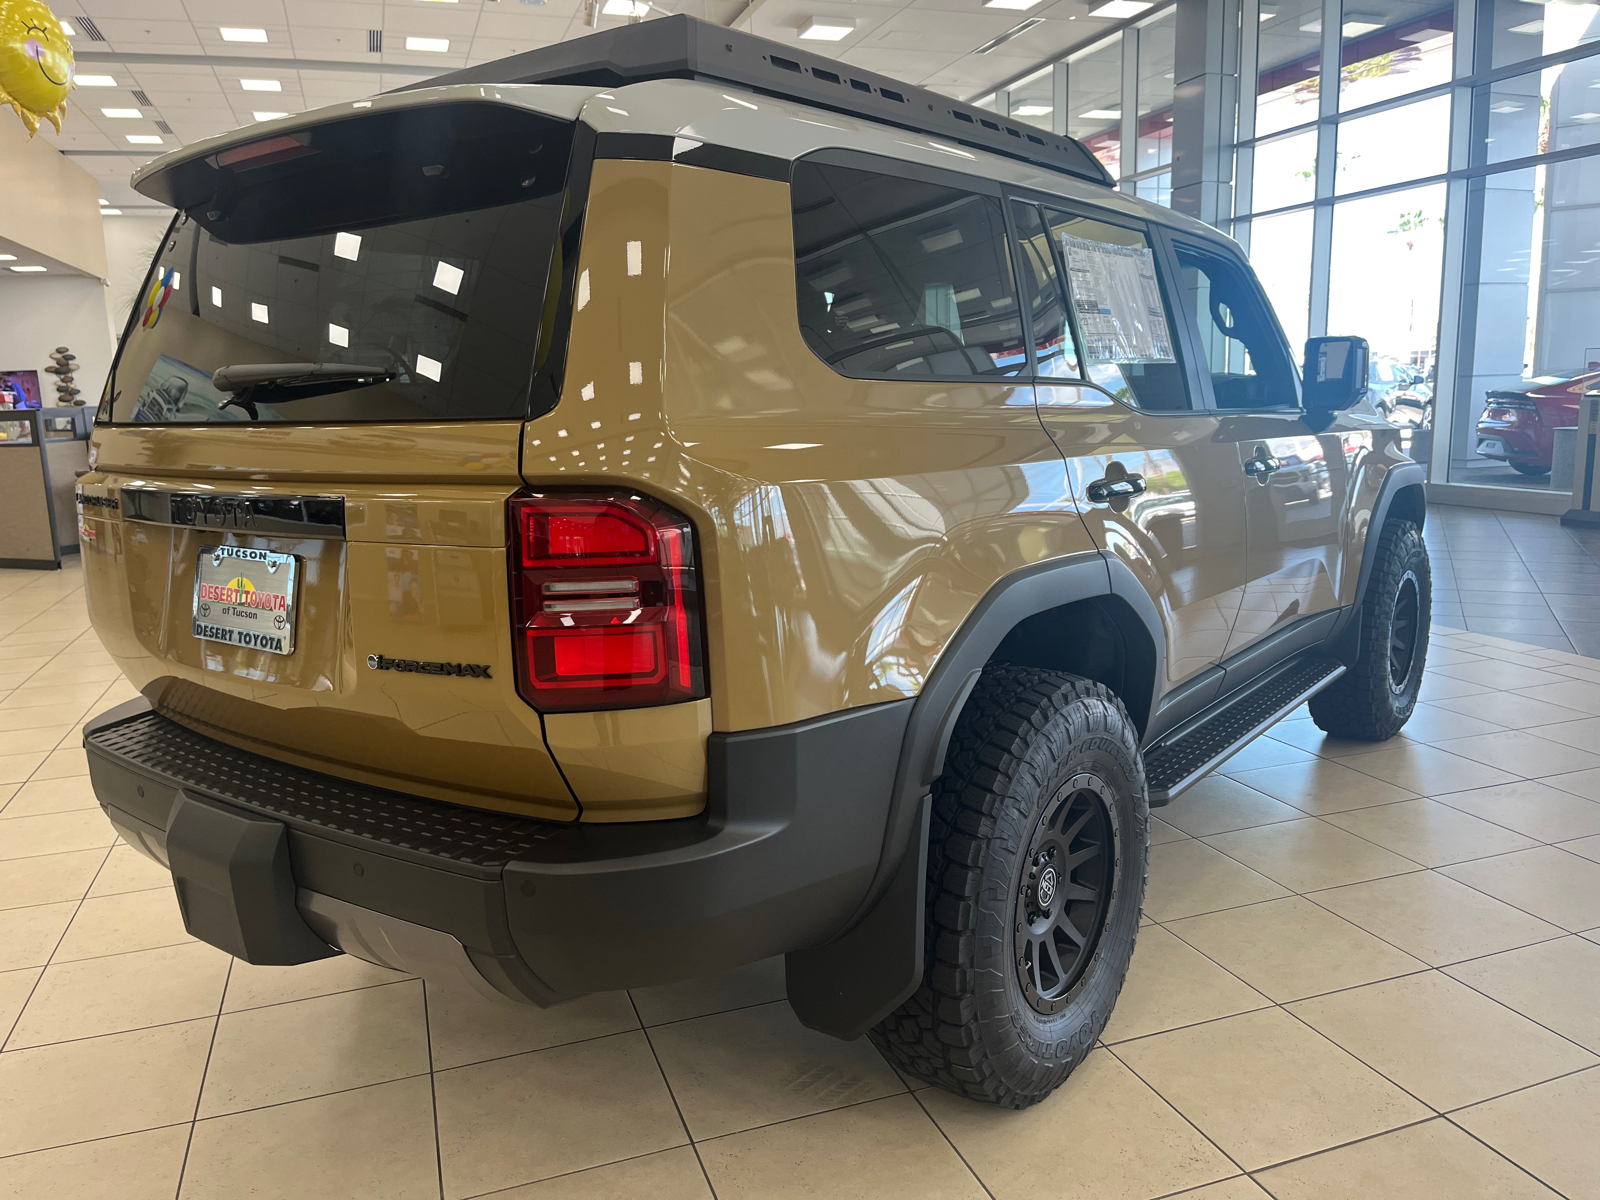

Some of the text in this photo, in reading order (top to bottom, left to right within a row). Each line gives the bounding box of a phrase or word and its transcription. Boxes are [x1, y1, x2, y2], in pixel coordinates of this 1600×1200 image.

[171, 495, 258, 528] TOYOTA
[220, 547, 267, 561] TUCSON
[200, 583, 287, 612] DESERT TOYOTA
[222, 606, 258, 620] of Tucson
[196, 623, 283, 653] DESERT TOYOTA
[1079, 736, 1137, 782] COUNTRY
